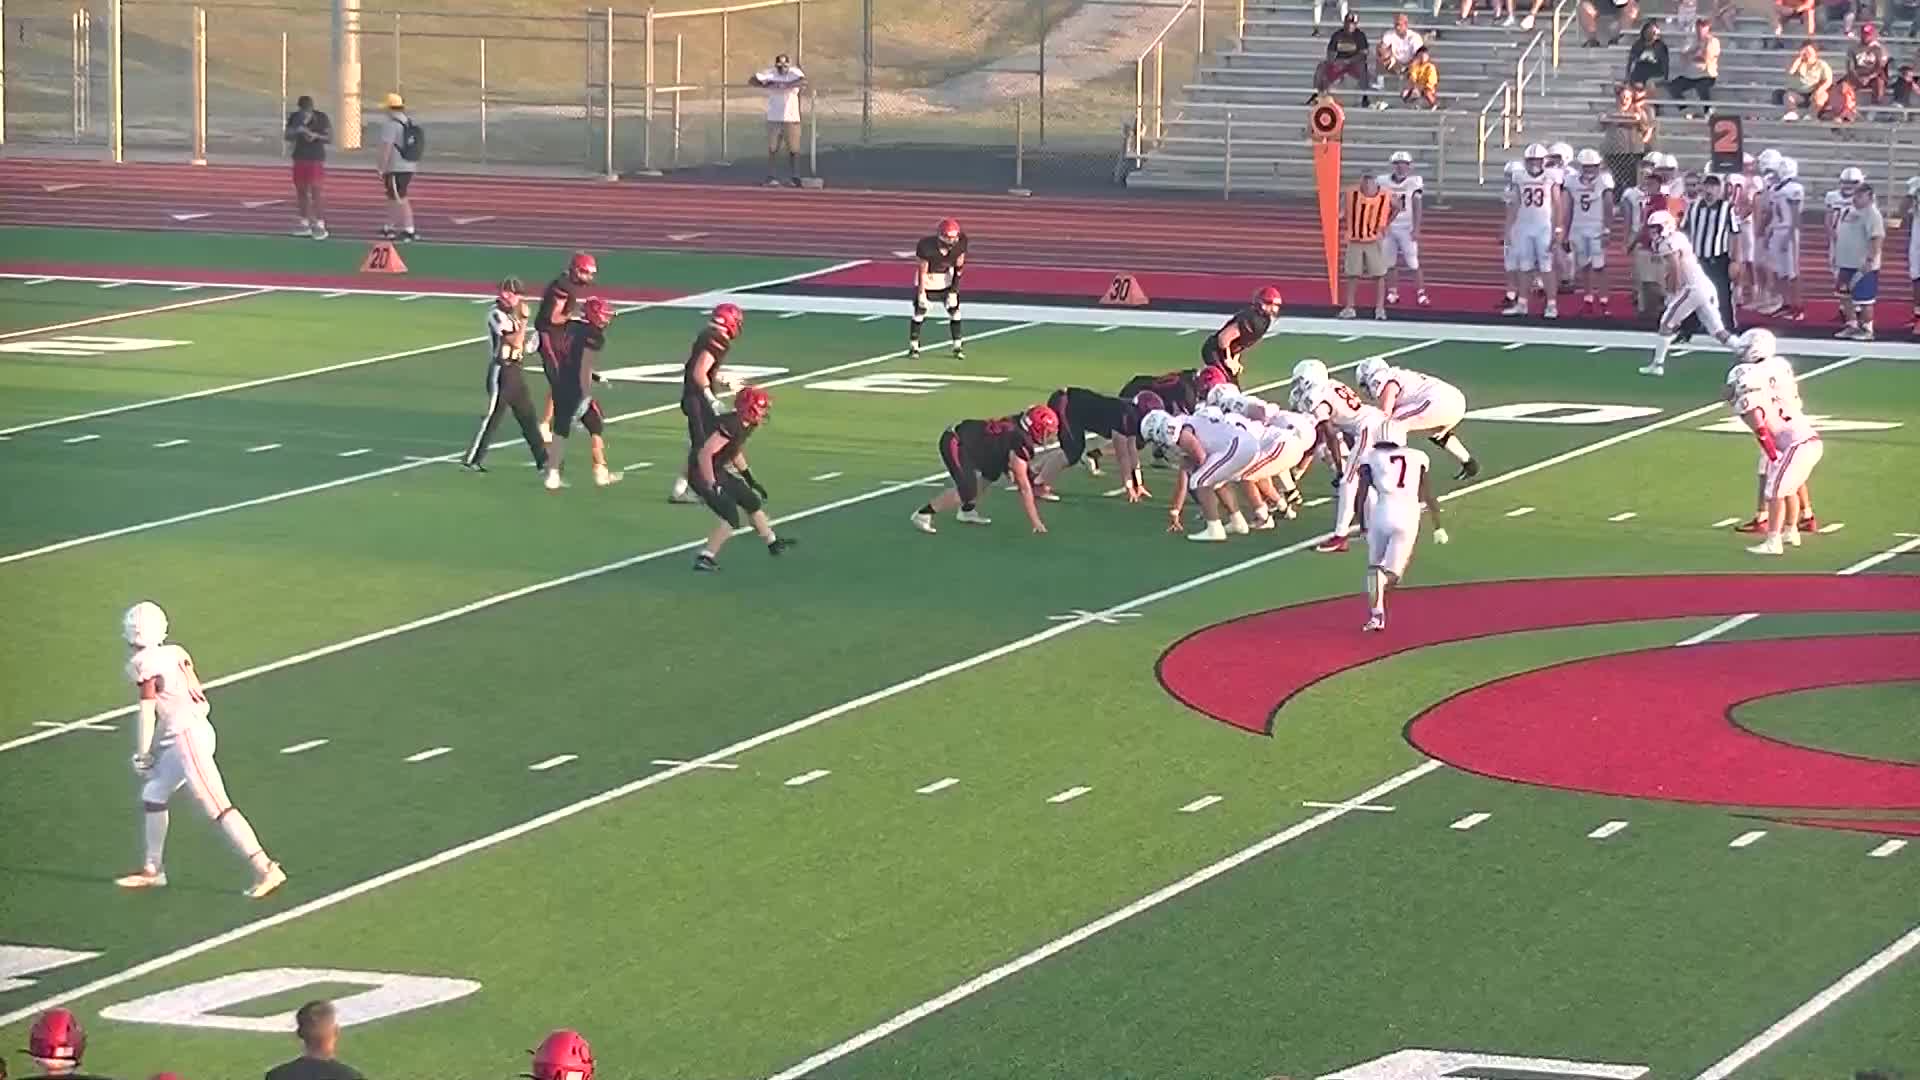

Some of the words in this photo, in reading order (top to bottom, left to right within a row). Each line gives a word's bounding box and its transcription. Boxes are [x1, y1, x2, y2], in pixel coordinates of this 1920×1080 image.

[1713, 119, 1738, 153] 2
[1523, 187, 1545, 208] 33
[369, 247, 390, 269] 20
[1110, 278, 1130, 301] 30
[1390, 455, 1407, 488] 7
